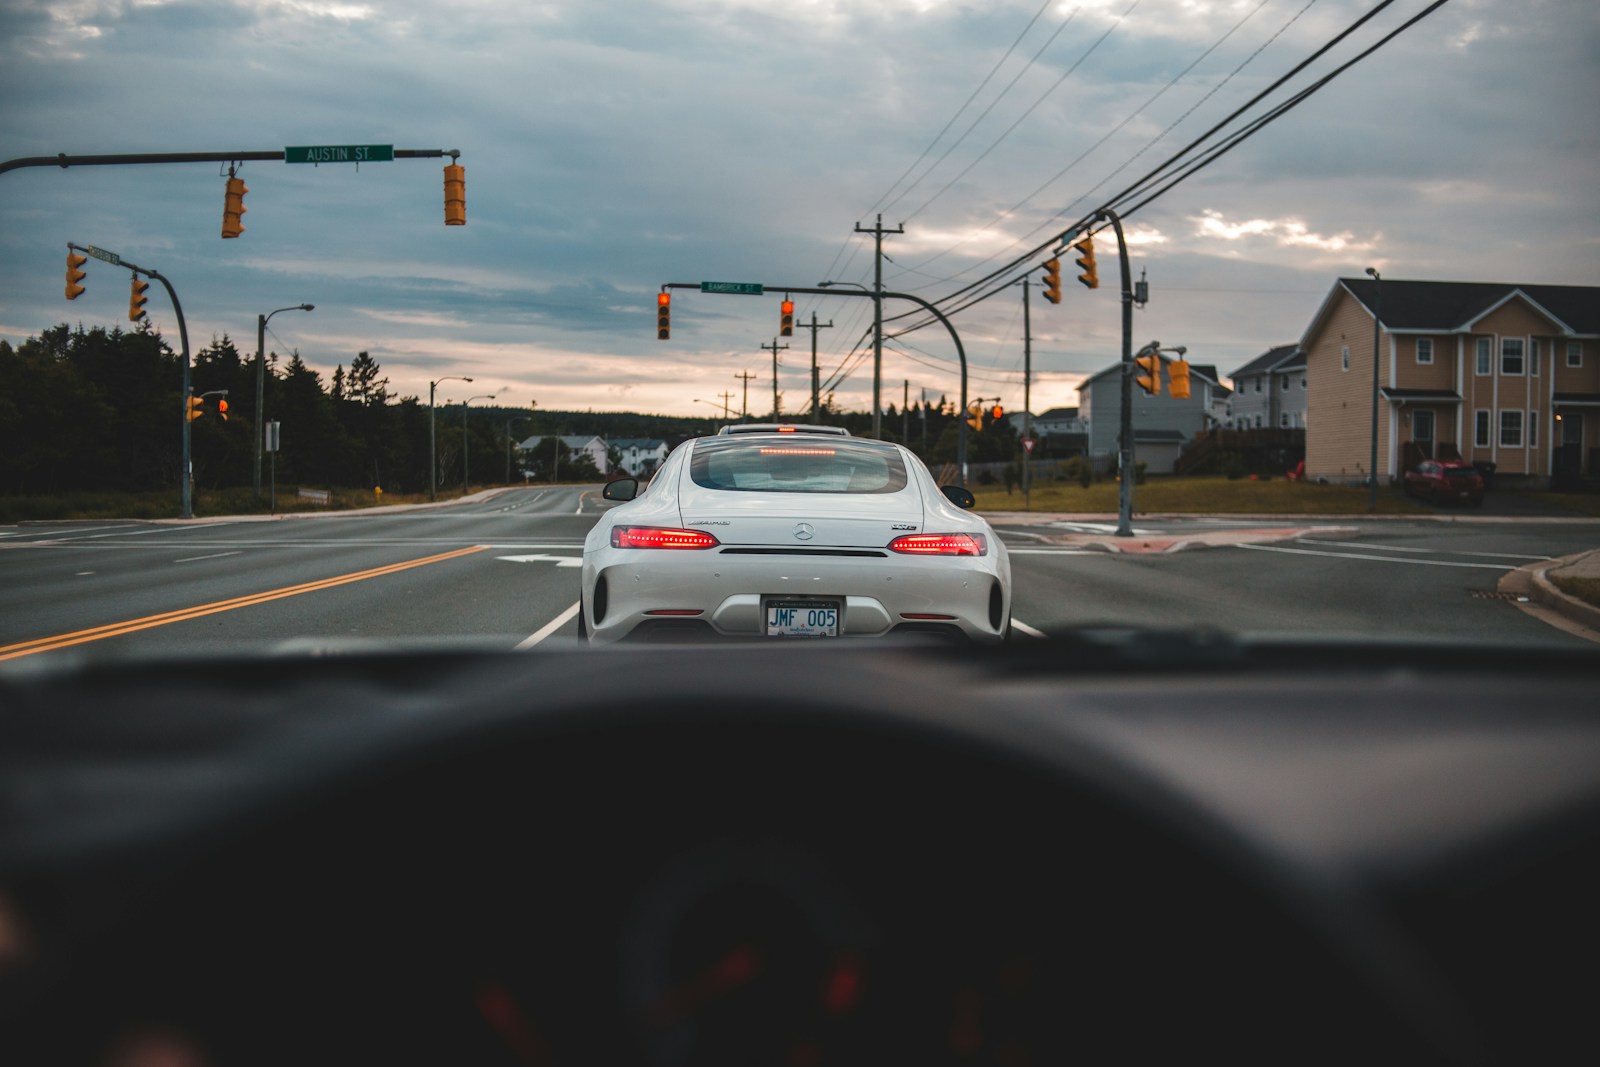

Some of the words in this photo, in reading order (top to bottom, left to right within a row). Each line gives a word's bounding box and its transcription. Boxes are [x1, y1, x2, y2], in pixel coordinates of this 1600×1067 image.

[307, 147, 348, 161] AUSTIN
[769, 609, 798, 626] JMF
[807, 609, 836, 627] 005
